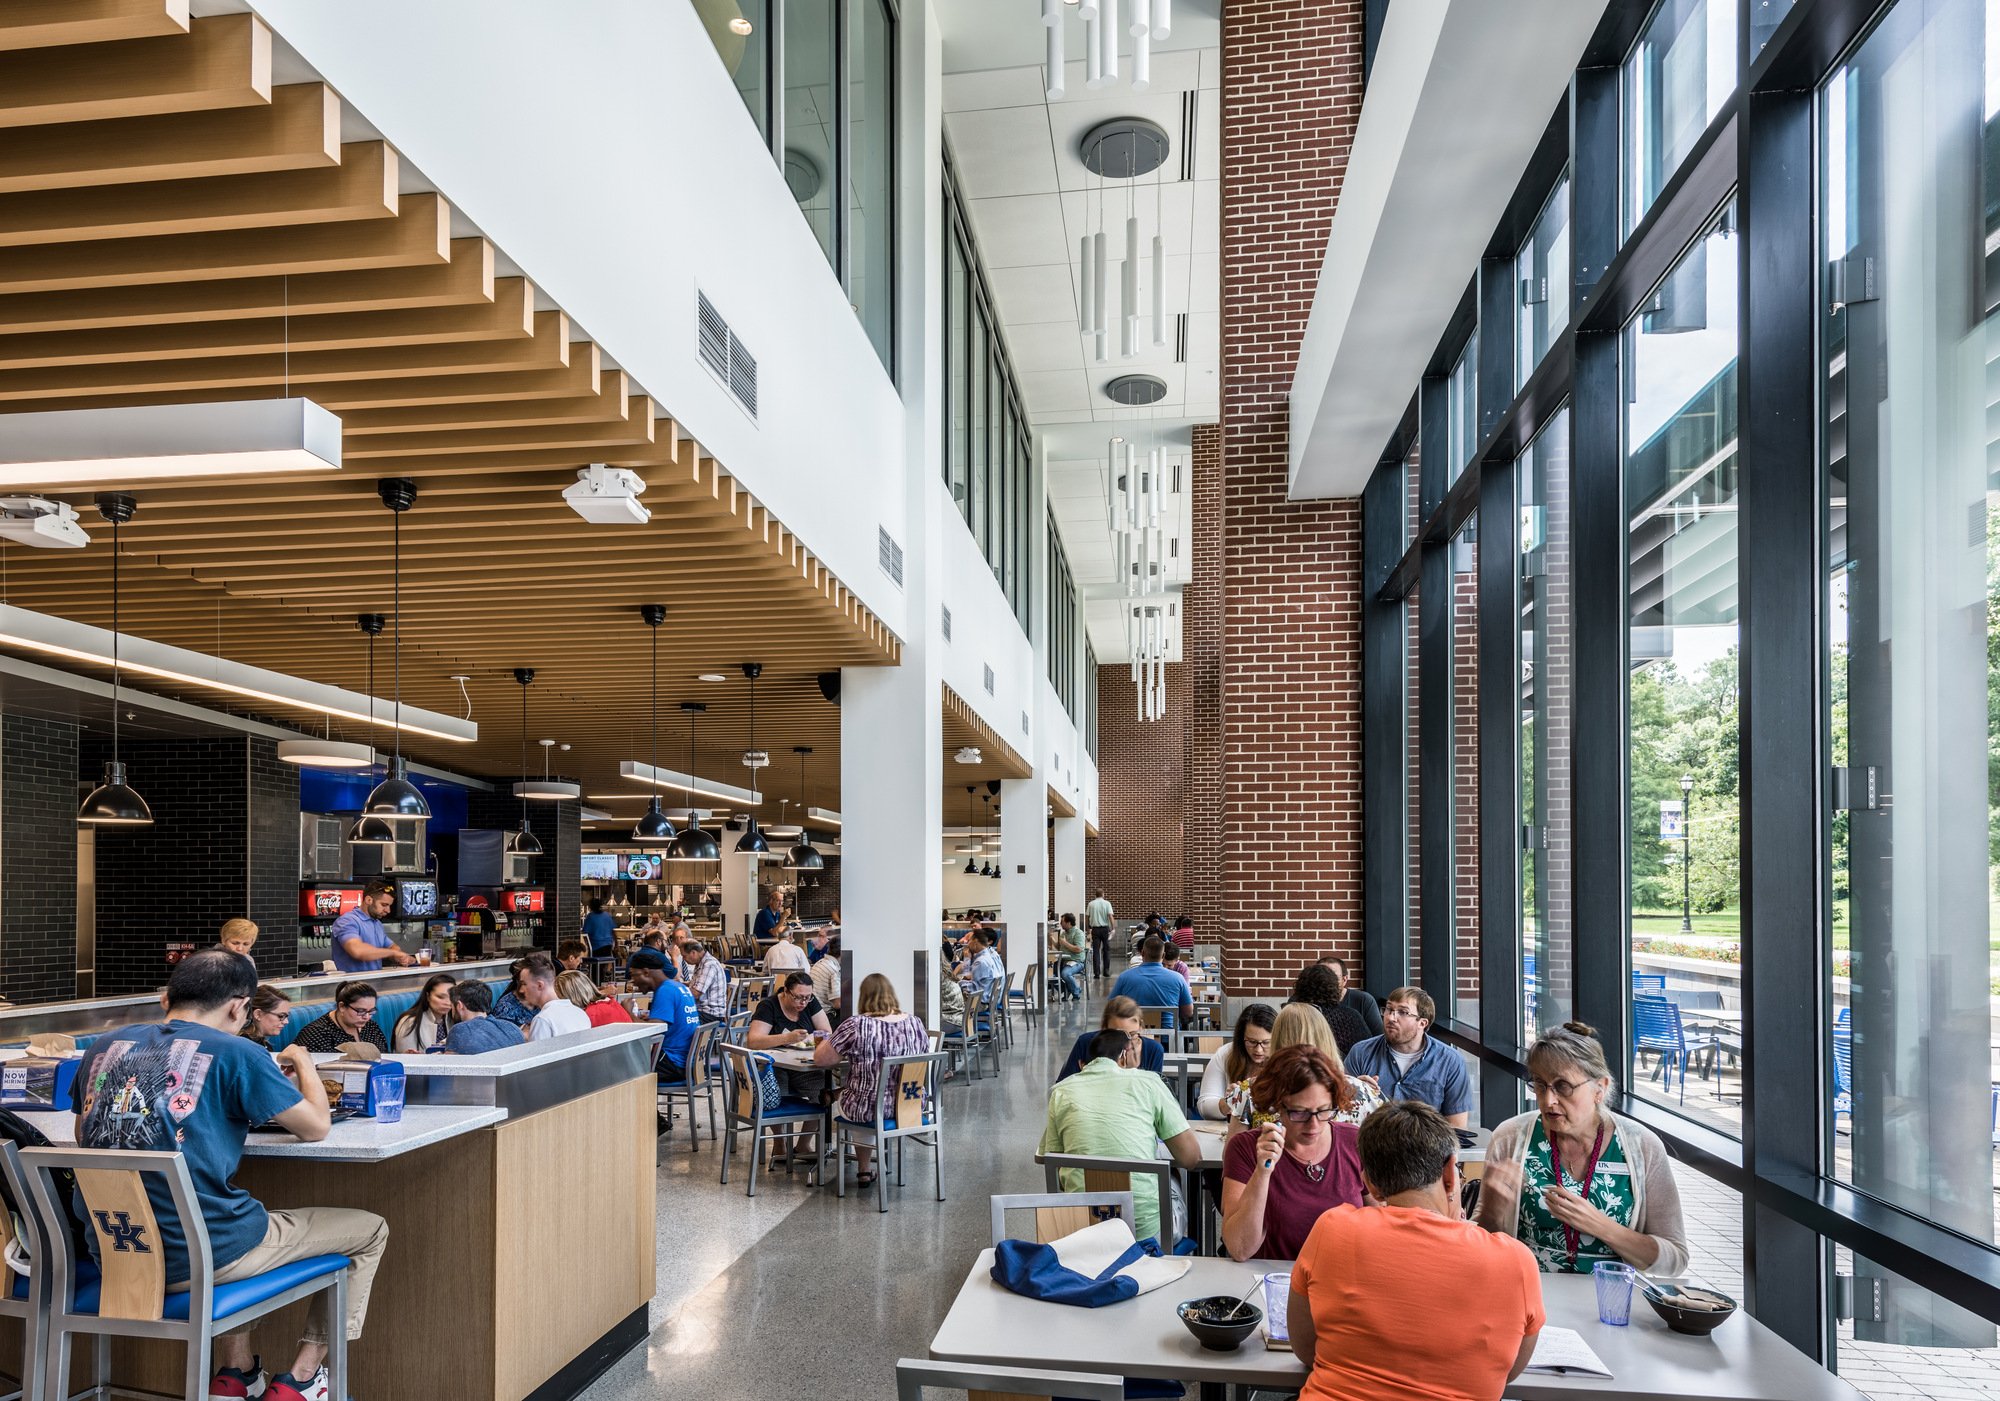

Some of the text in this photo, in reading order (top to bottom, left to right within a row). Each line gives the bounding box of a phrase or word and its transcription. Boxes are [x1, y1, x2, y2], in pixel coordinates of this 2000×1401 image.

[409, 889, 429, 906] ICE
[902, 1081, 921, 1100] UK
[93, 1210, 152, 1253] UK
